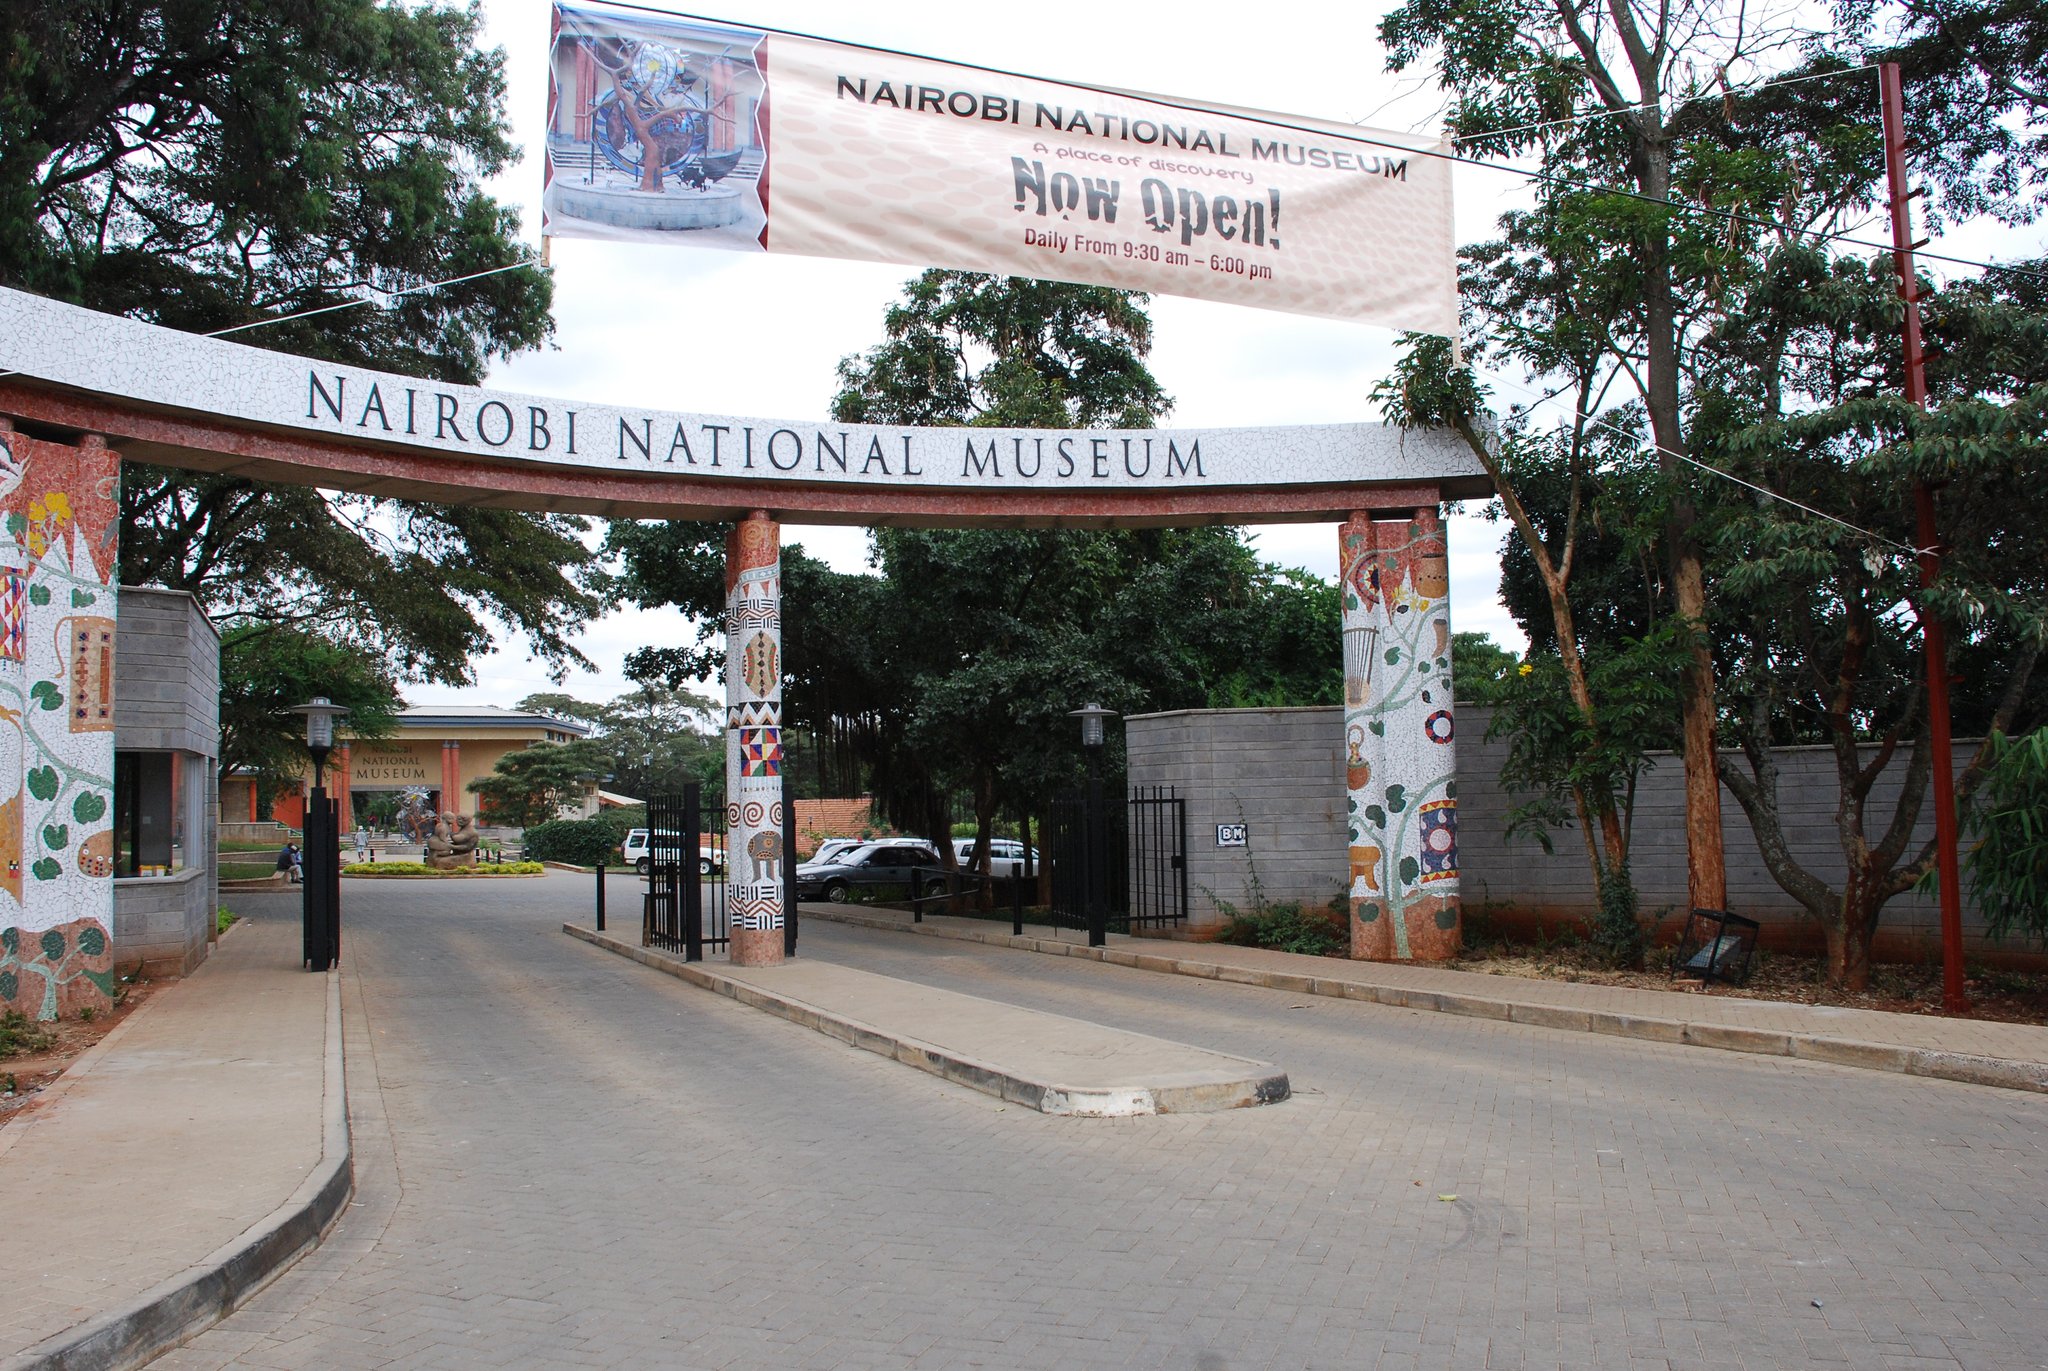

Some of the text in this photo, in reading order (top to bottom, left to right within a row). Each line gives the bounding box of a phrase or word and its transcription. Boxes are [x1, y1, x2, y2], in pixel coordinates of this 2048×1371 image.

[837, 75, 1408, 182] NAIROBI NATIONAL MUSEUM
[1033, 142, 1254, 185] A place of discovery
[1011, 156, 1281, 250] Now Open!
[1024, 228, 1068, 253] Daily
[1074, 234, 1117, 256] From
[1123, 242, 1159, 262] 9:30
[1165, 251, 1189, 266] am
[1210, 254, 1244, 275] 6:00
[1249, 263, 1272, 280] pm
[306, 370, 1207, 478] NAIROBI NATIONAL MUSEUM
[362, 756, 420, 766] NATIONAL
[372, 745, 413, 754] NROBI
[356, 768, 426, 779] MUSEUM
